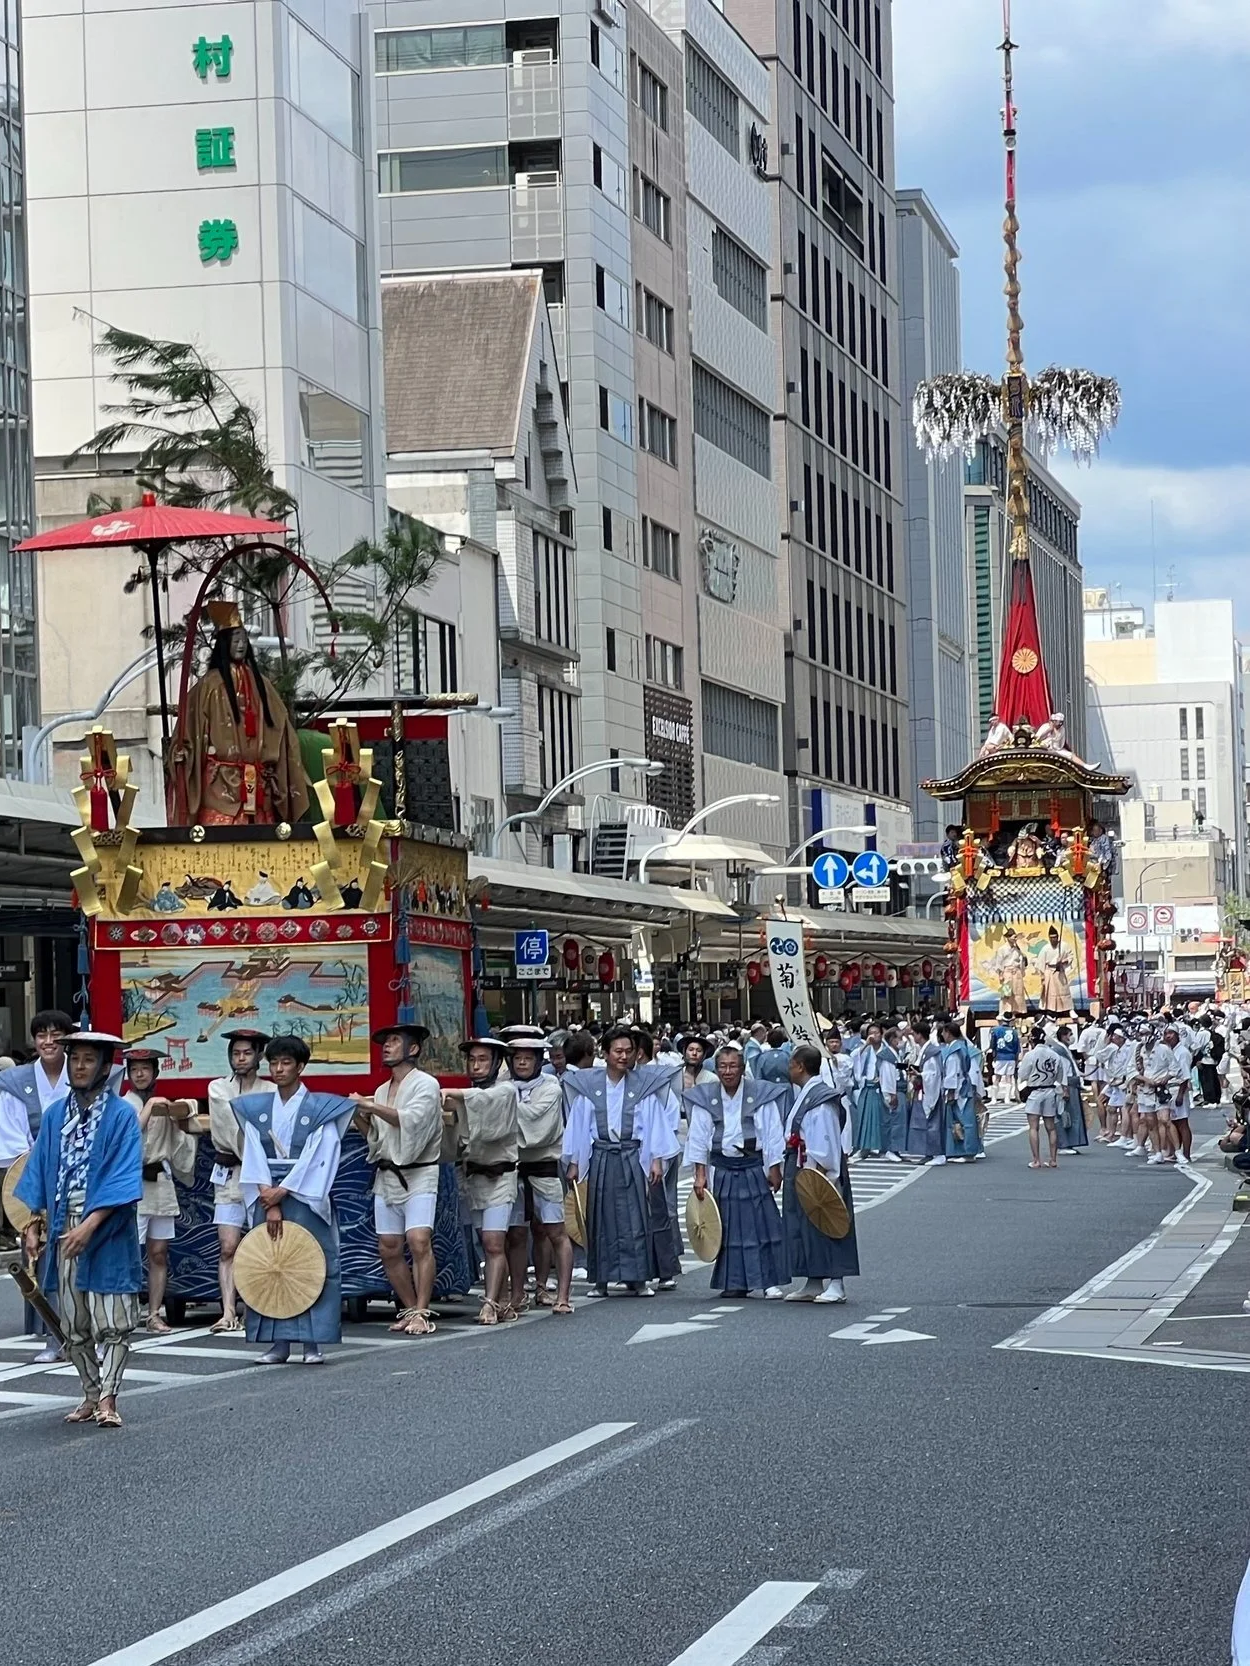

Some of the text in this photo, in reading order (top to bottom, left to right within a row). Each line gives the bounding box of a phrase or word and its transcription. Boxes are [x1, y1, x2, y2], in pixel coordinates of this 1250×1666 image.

[192, 34, 238, 262] 村証券
[520, 936, 543, 960] 停
[518, 967, 549, 976] ここまで
